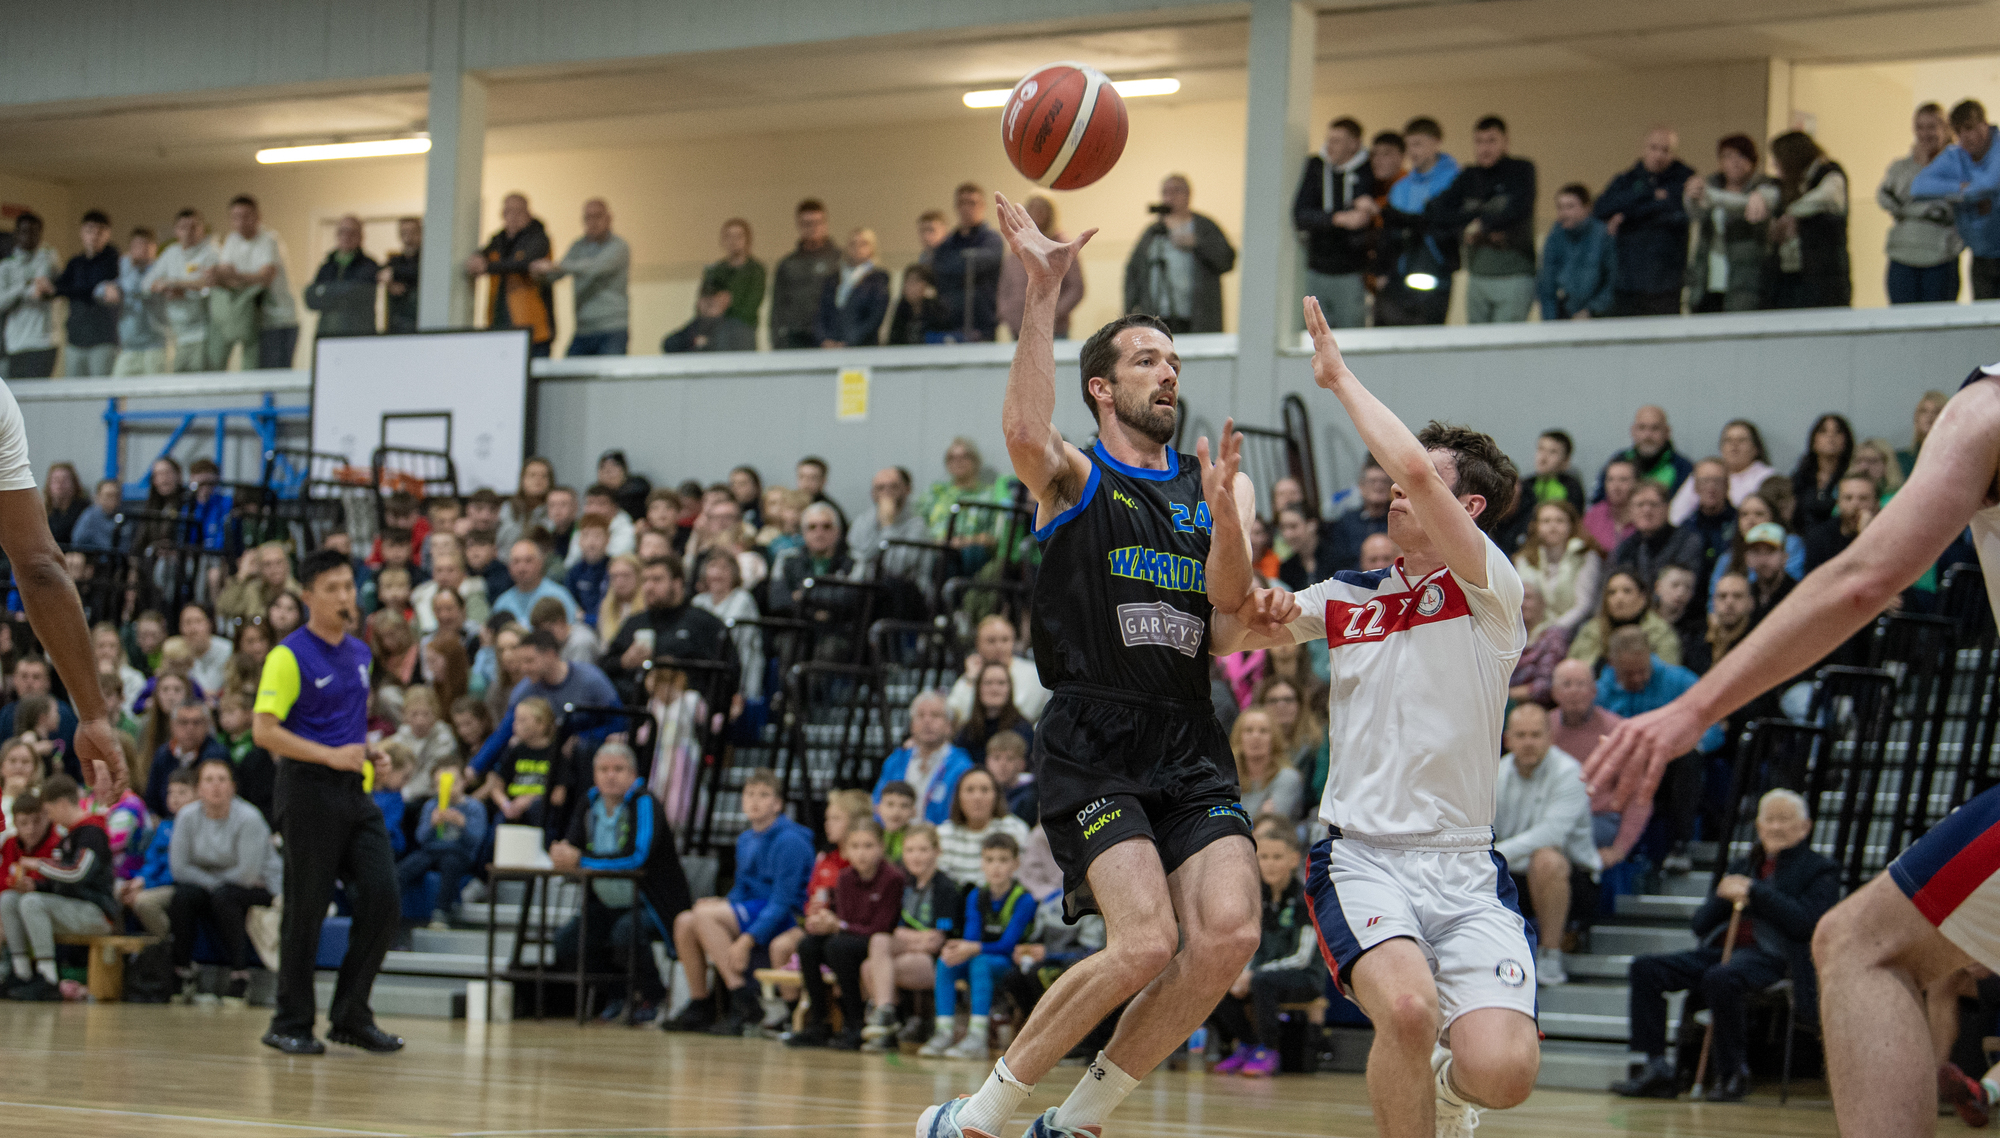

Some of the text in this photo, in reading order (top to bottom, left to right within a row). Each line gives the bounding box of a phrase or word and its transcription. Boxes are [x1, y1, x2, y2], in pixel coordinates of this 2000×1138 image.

[1169, 500, 1212, 535] 24
[1108, 545, 1207, 594] WARRIOR
[1343, 599, 1386, 639] 22
